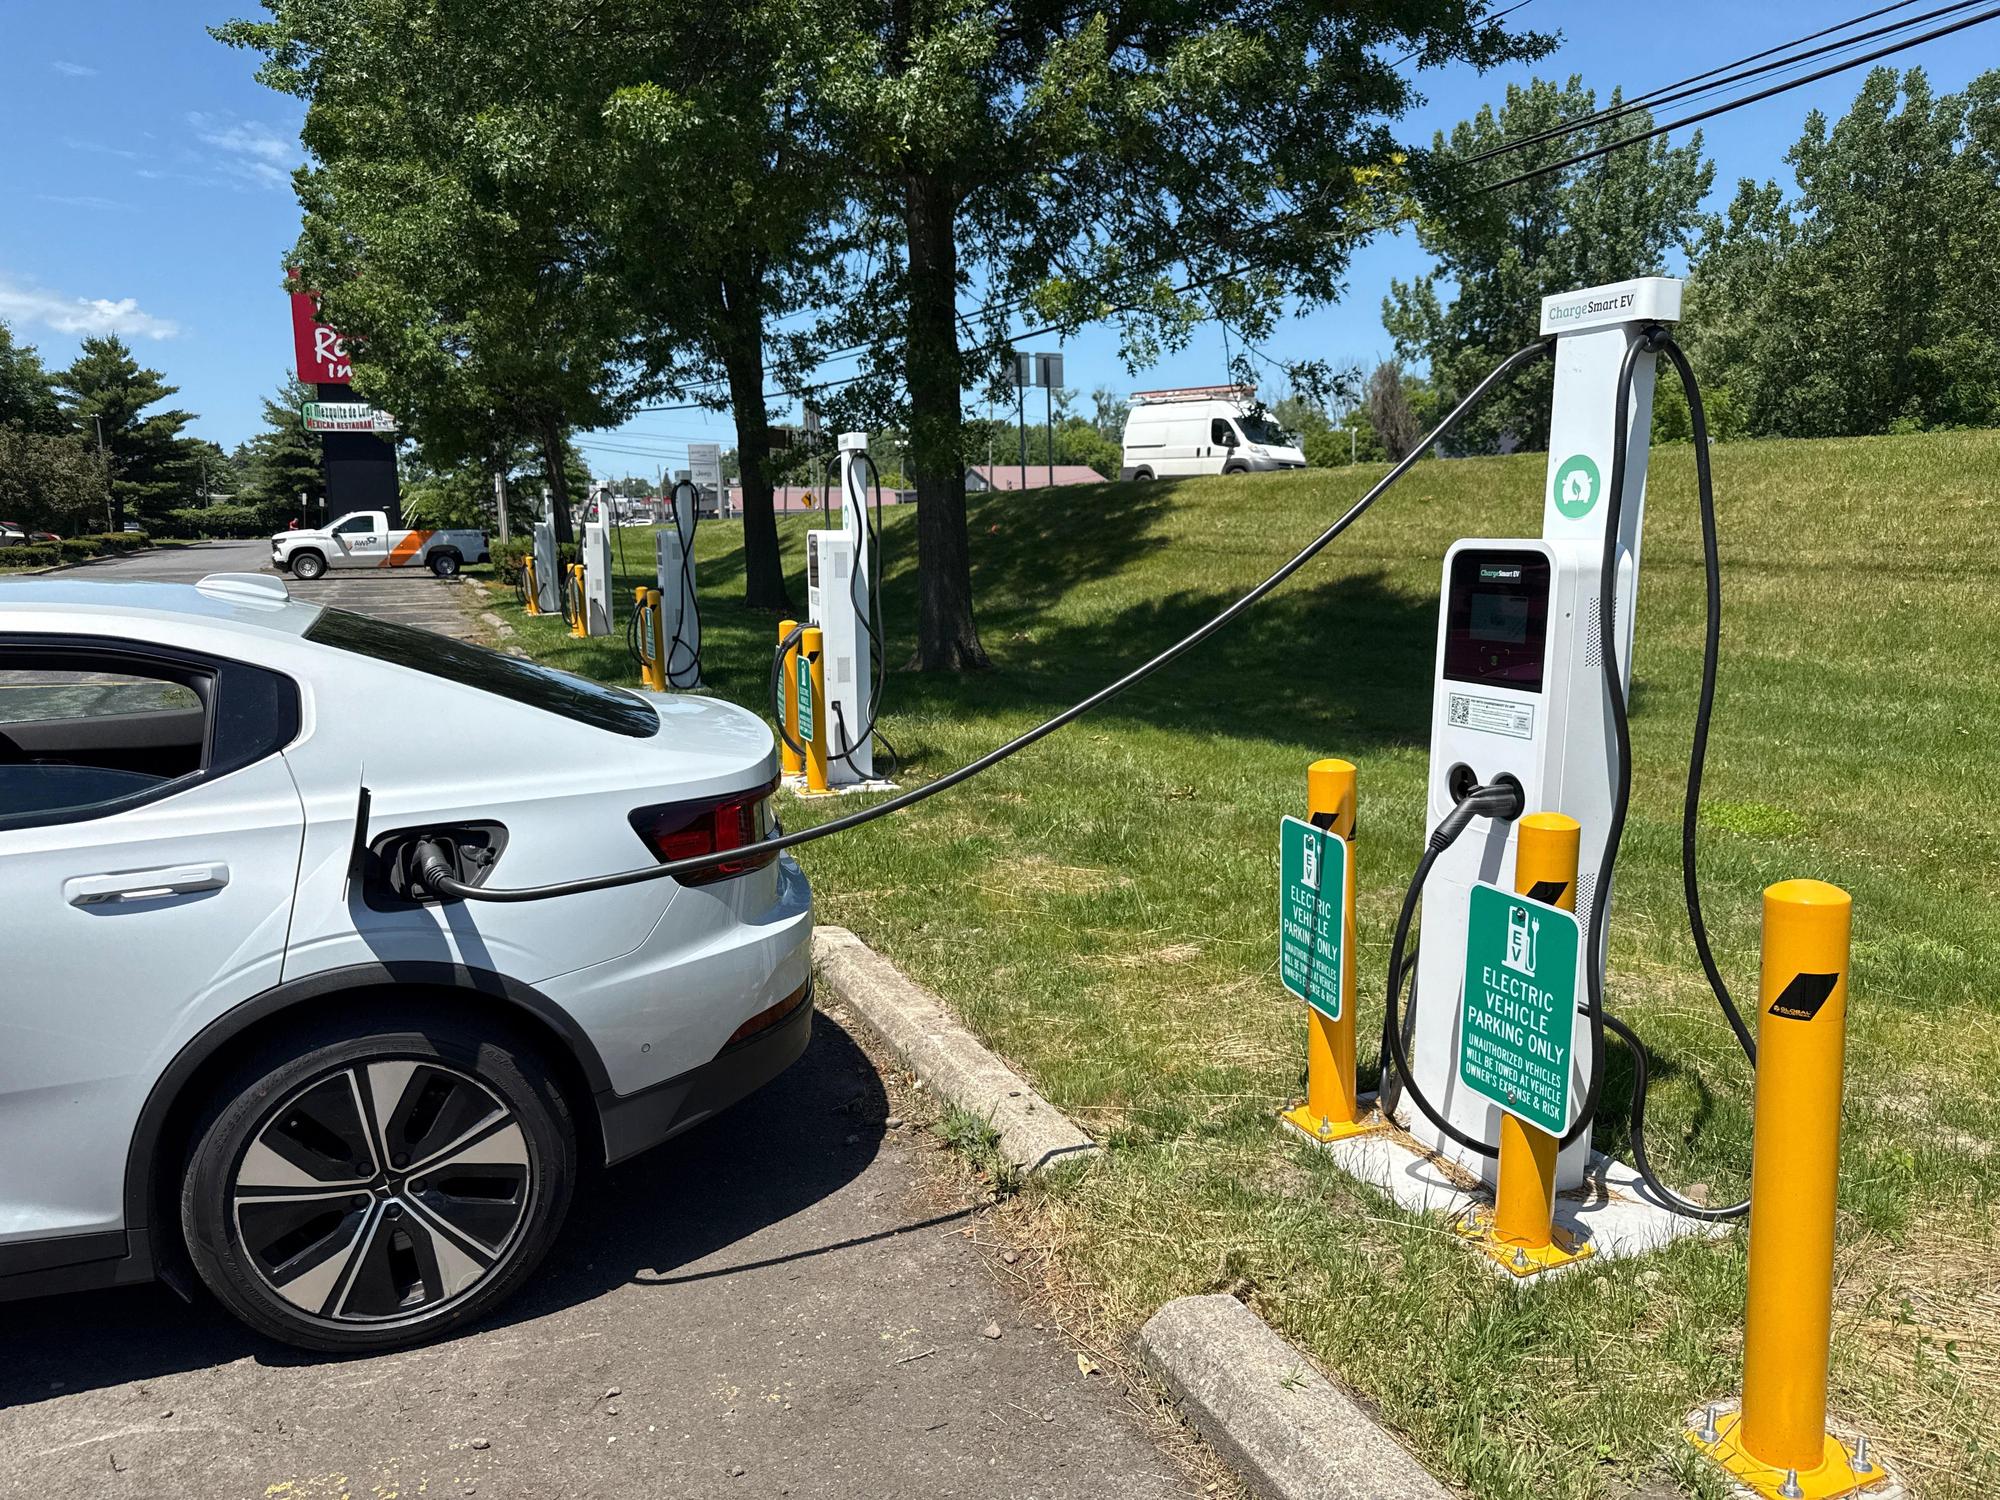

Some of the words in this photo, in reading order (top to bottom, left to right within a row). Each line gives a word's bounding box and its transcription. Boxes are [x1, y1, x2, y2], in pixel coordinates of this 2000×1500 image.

[1549, 298, 1618, 320] ChargeSmart
[1620, 293, 1635, 308] EV
[314, 327, 351, 363] Ro
[328, 363, 353, 378] in
[306, 417, 335, 429] MEXICAN
[336, 418, 375, 429] RESTAURANT
[348, 405, 356, 418] de
[1481, 570, 1512, 578] ChargeSmart
[1306, 853, 1312, 880] EV
[1291, 885, 1331, 919] ELECTRIC
[1293, 904, 1328, 937] VEHICLE
[1284, 918, 1315, 949] PARKING
[1317, 938, 1337, 961] ONLY
[1512, 930, 1522, 961] EV
[1294, 959, 1299, 970] BE
[1319, 974, 1336, 995] VEHICLE
[1316, 959, 1336, 981] VEHICLES
[1302, 976, 1321, 998] EENSE
[1483, 966, 1553, 1012] ELECTRIC
[1486, 990, 1548, 1035] VEHICLE
[1468, 1005, 1523, 1047] PARKING
[1528, 1034, 1564, 1065] ONLY
[1466, 1046, 1482, 1065] WILL
[1484, 1055, 1493, 1070] BE
[1495, 1061, 1518, 1081] TOWED
[1520, 1074, 1529, 1088] AT
[1531, 1078, 1561, 1105] VEHICLE
[1469, 1032, 1522, 1069] UNAUTHORIZED
[1525, 1060, 1561, 1088] VEHICLES
[1466, 1061, 1497, 1087] OWNER'S
[1533, 1096, 1540, 1110] &
[1542, 1101, 1560, 1120] RISK
